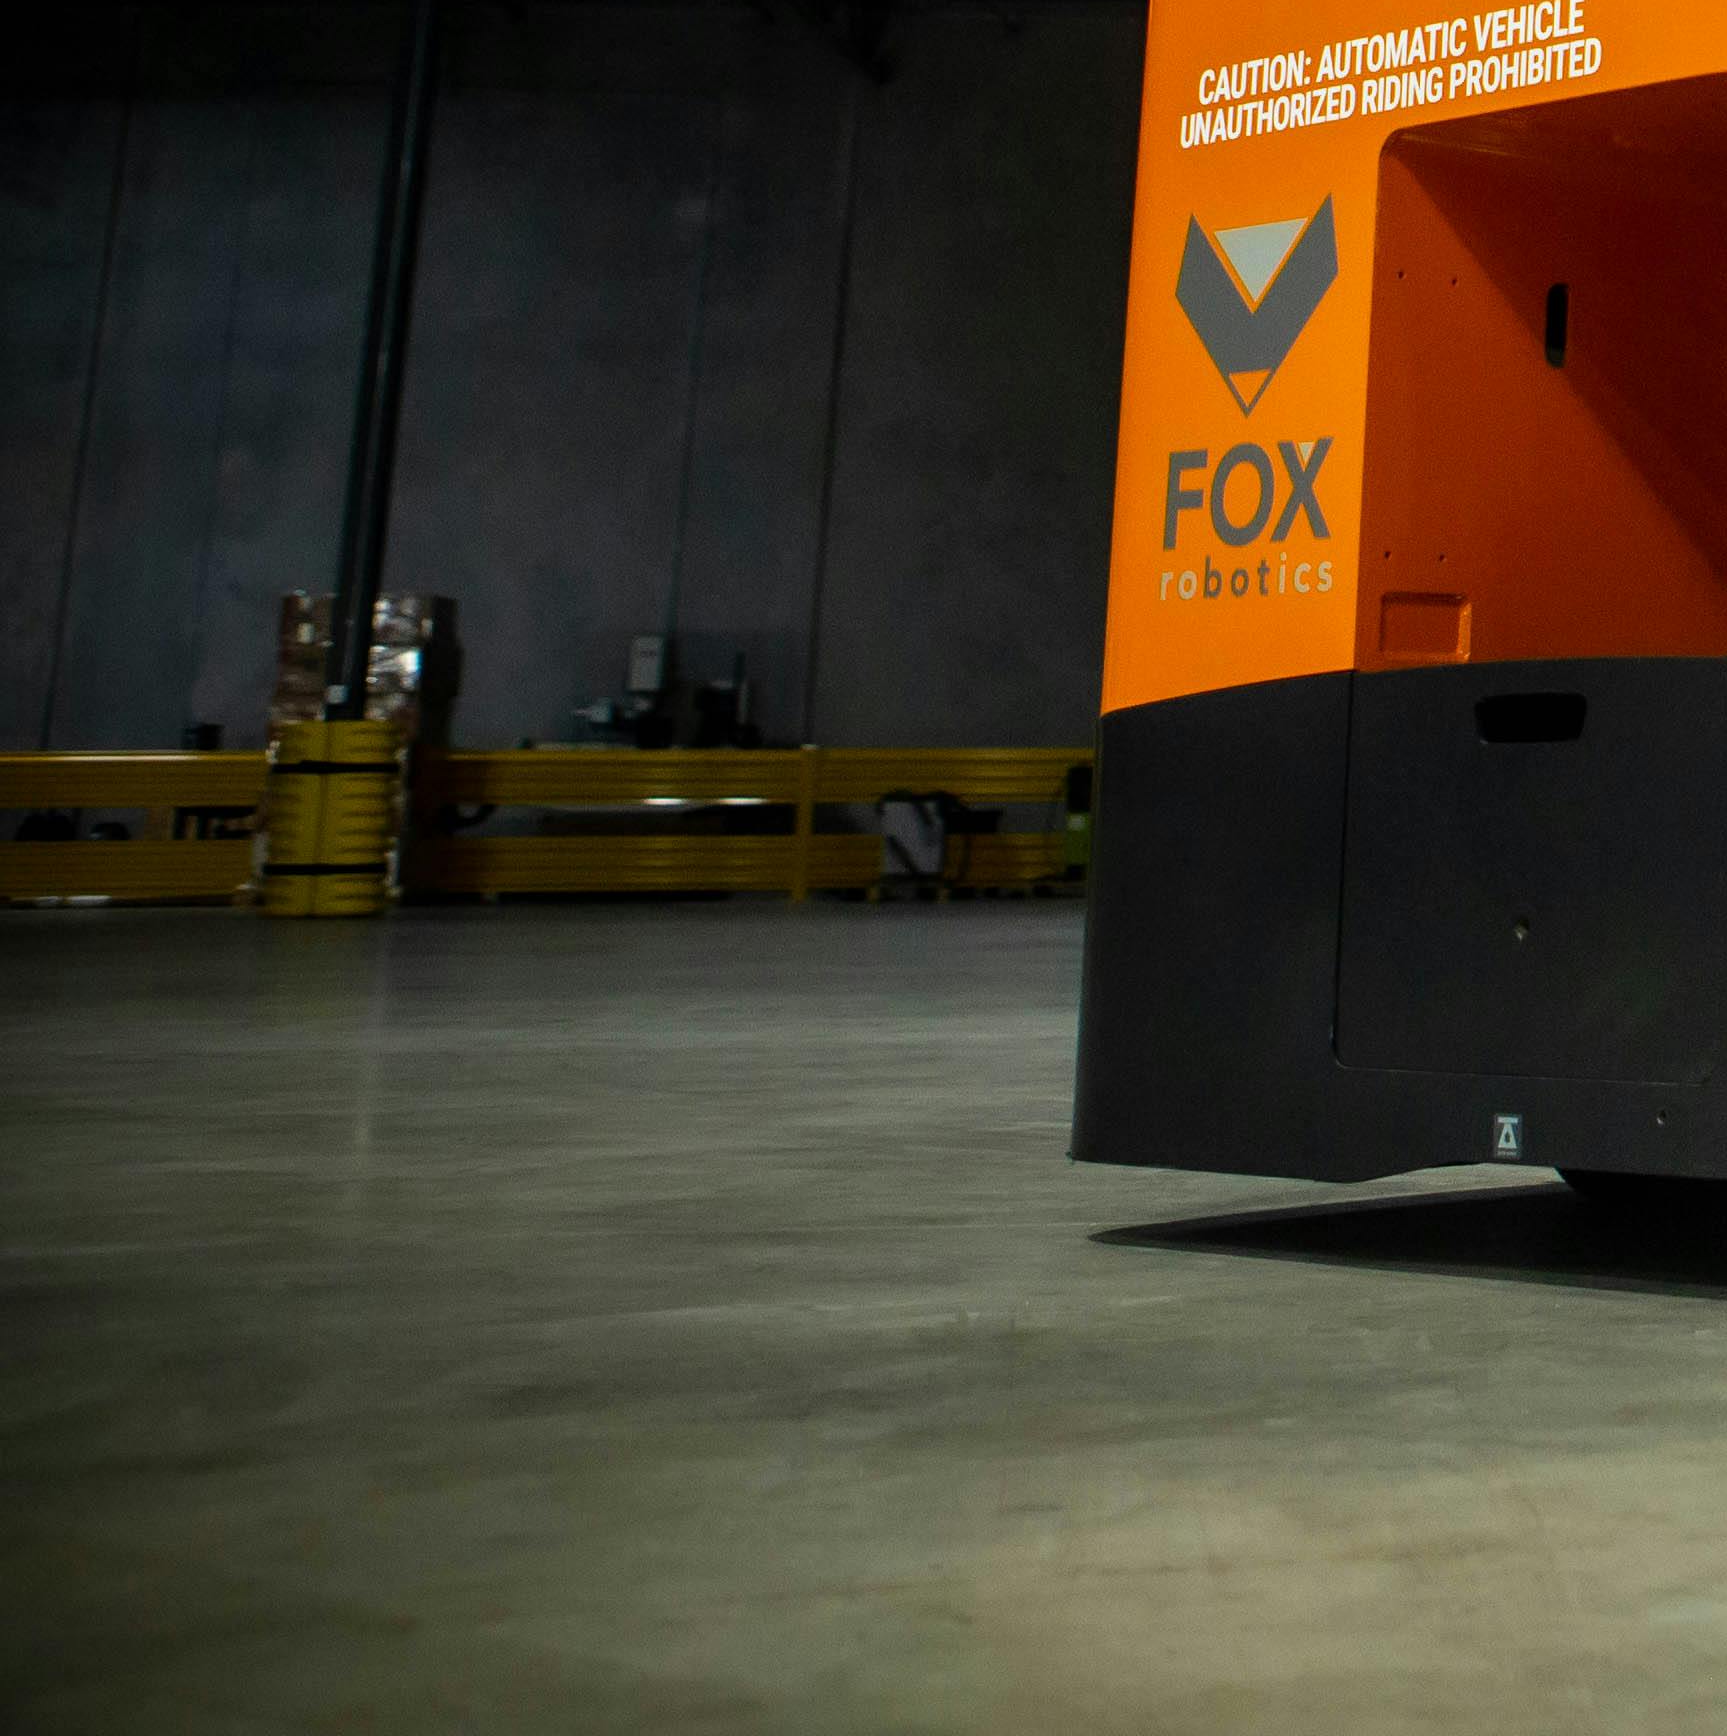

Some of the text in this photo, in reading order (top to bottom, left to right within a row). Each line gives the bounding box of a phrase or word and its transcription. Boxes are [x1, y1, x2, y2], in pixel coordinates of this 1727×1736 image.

[1180, 37, 1602, 149] UNAUTHORIZED RIDING PROHIBITED
[1199, 50, 1312, 105] CAUTION:
[1316, 18, 1468, 83] AUTOMATIC
[1163, 437, 1333, 551] FOX
[1160, 551, 1333, 601] robotics
